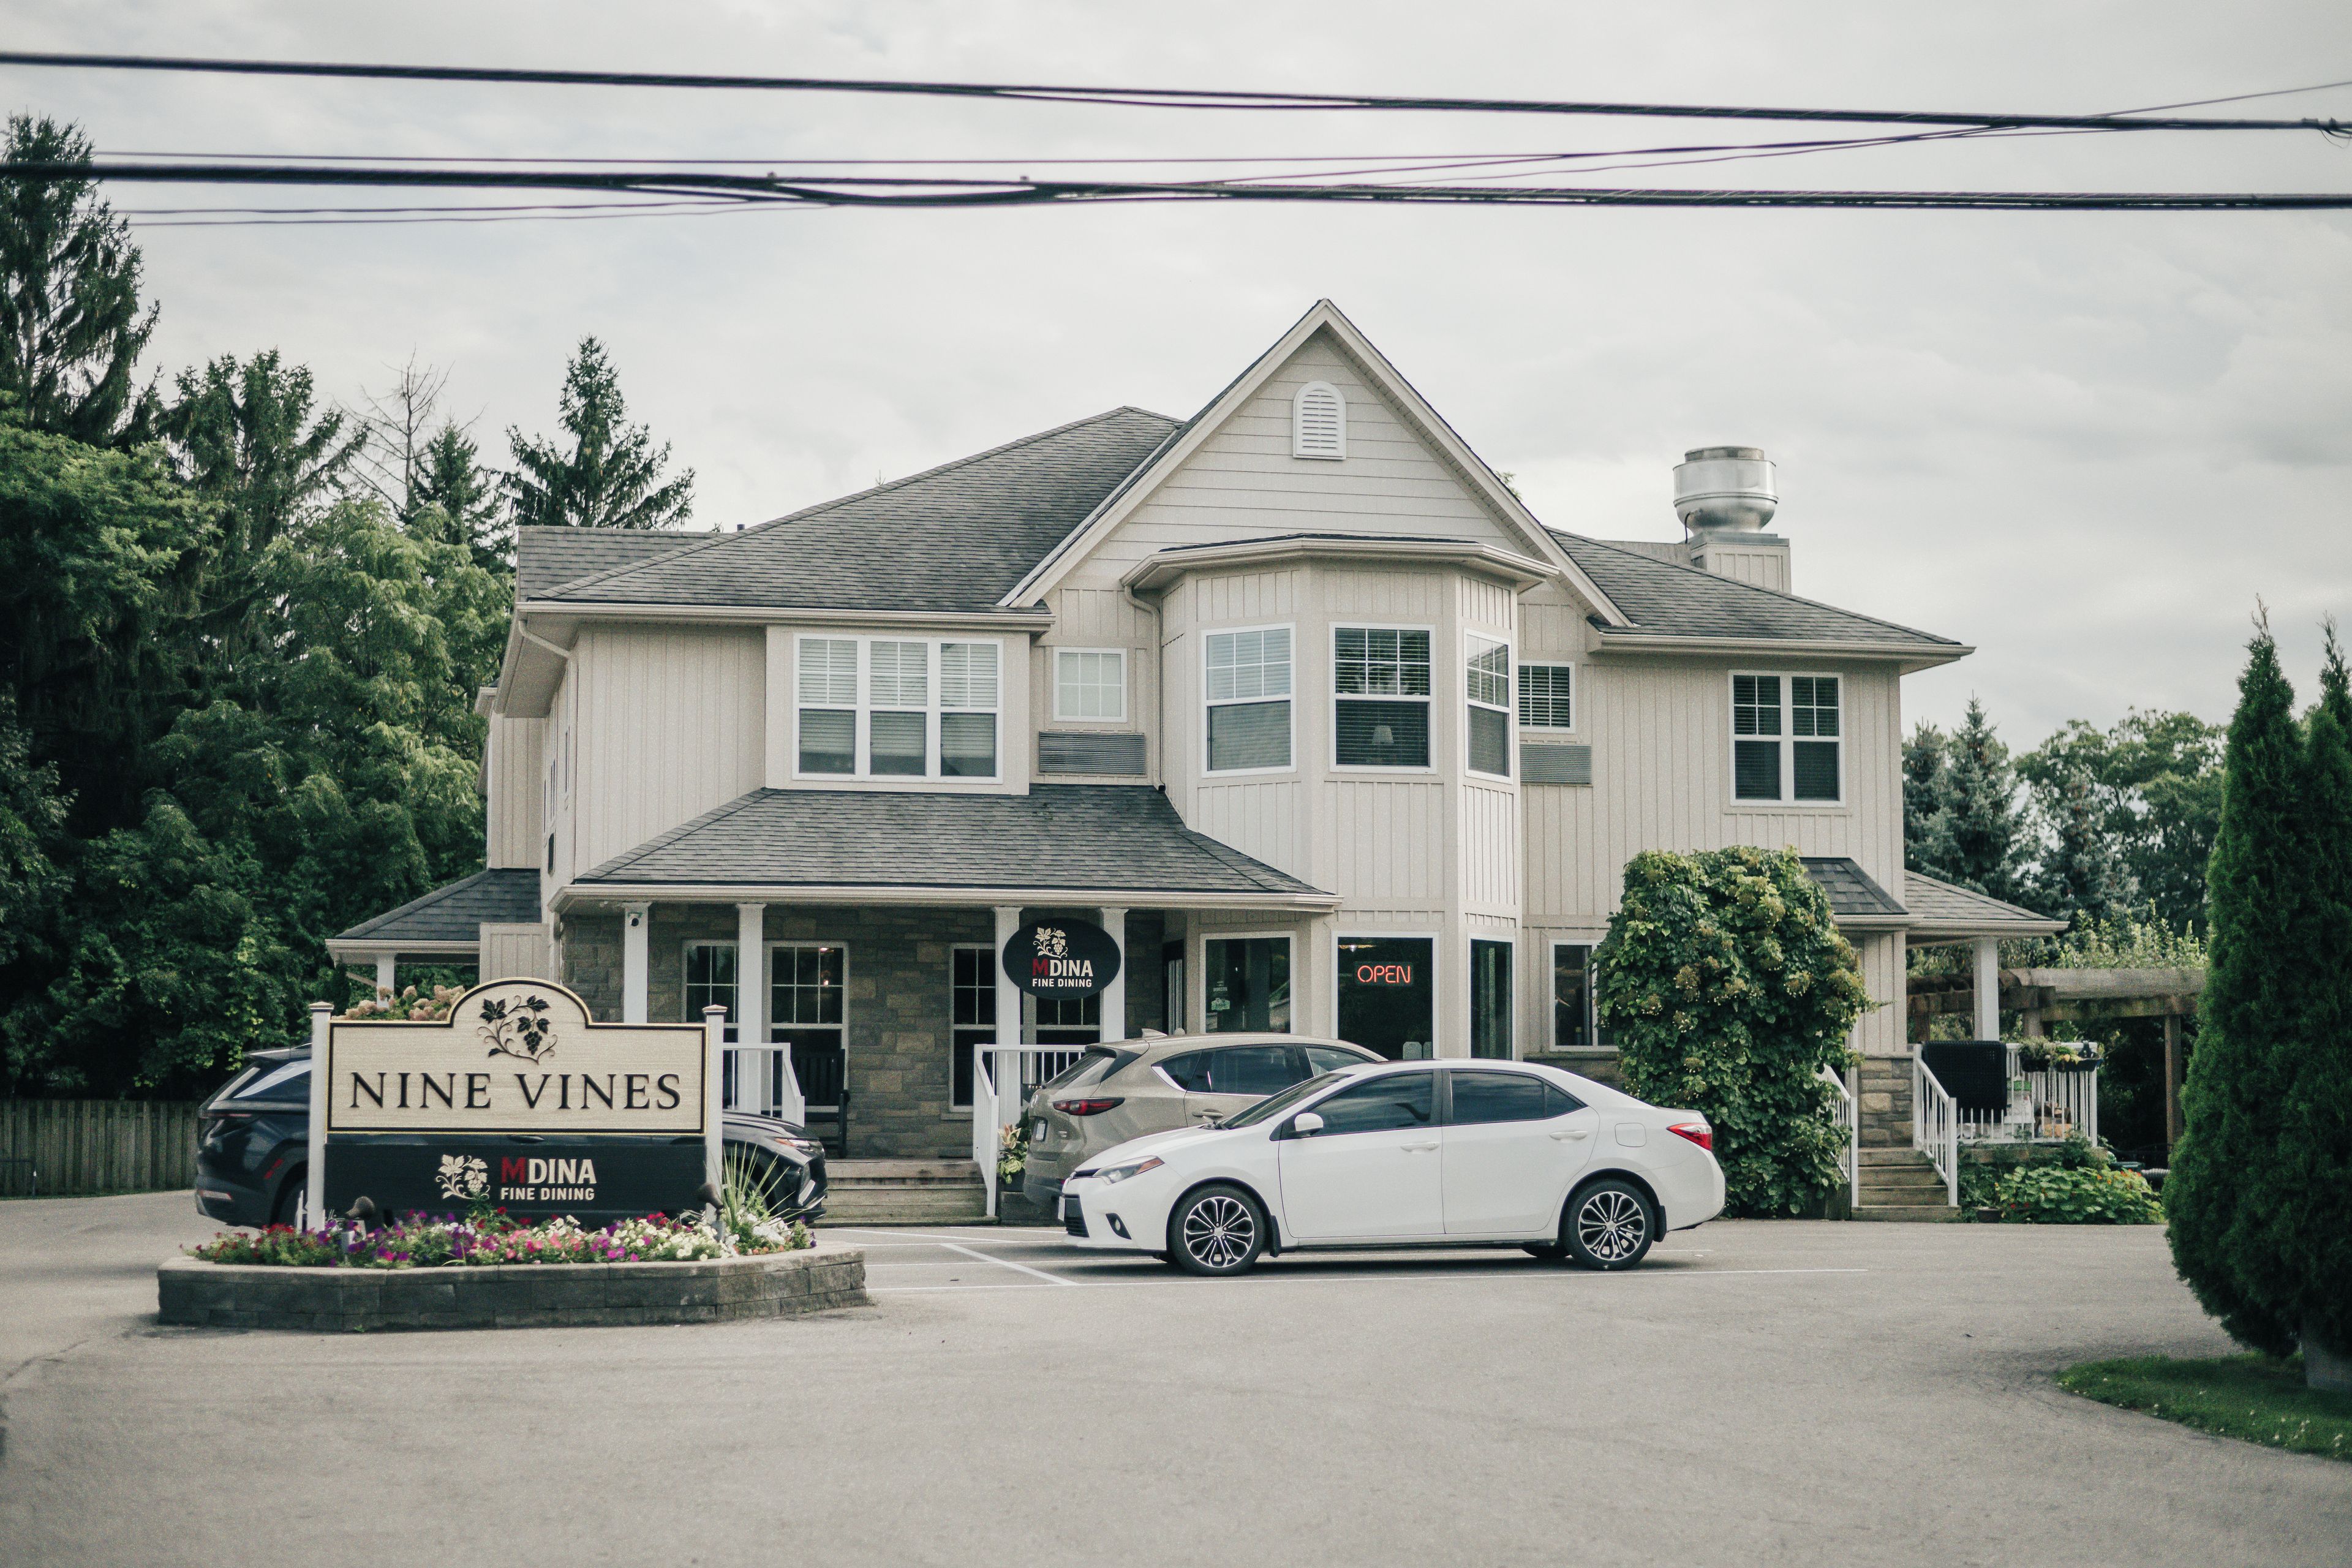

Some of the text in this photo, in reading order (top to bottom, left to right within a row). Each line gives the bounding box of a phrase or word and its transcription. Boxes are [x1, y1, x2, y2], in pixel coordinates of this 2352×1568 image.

[1033, 958, 1093, 977] MDINA
[1357, 965, 1411, 983] OPEN
[1032, 978, 1092, 987] FINE DINING
[350, 1072, 680, 1109] NINE VINES
[500, 1157, 597, 1184] MDINA
[500, 1187, 594, 1201] FINE DINING
